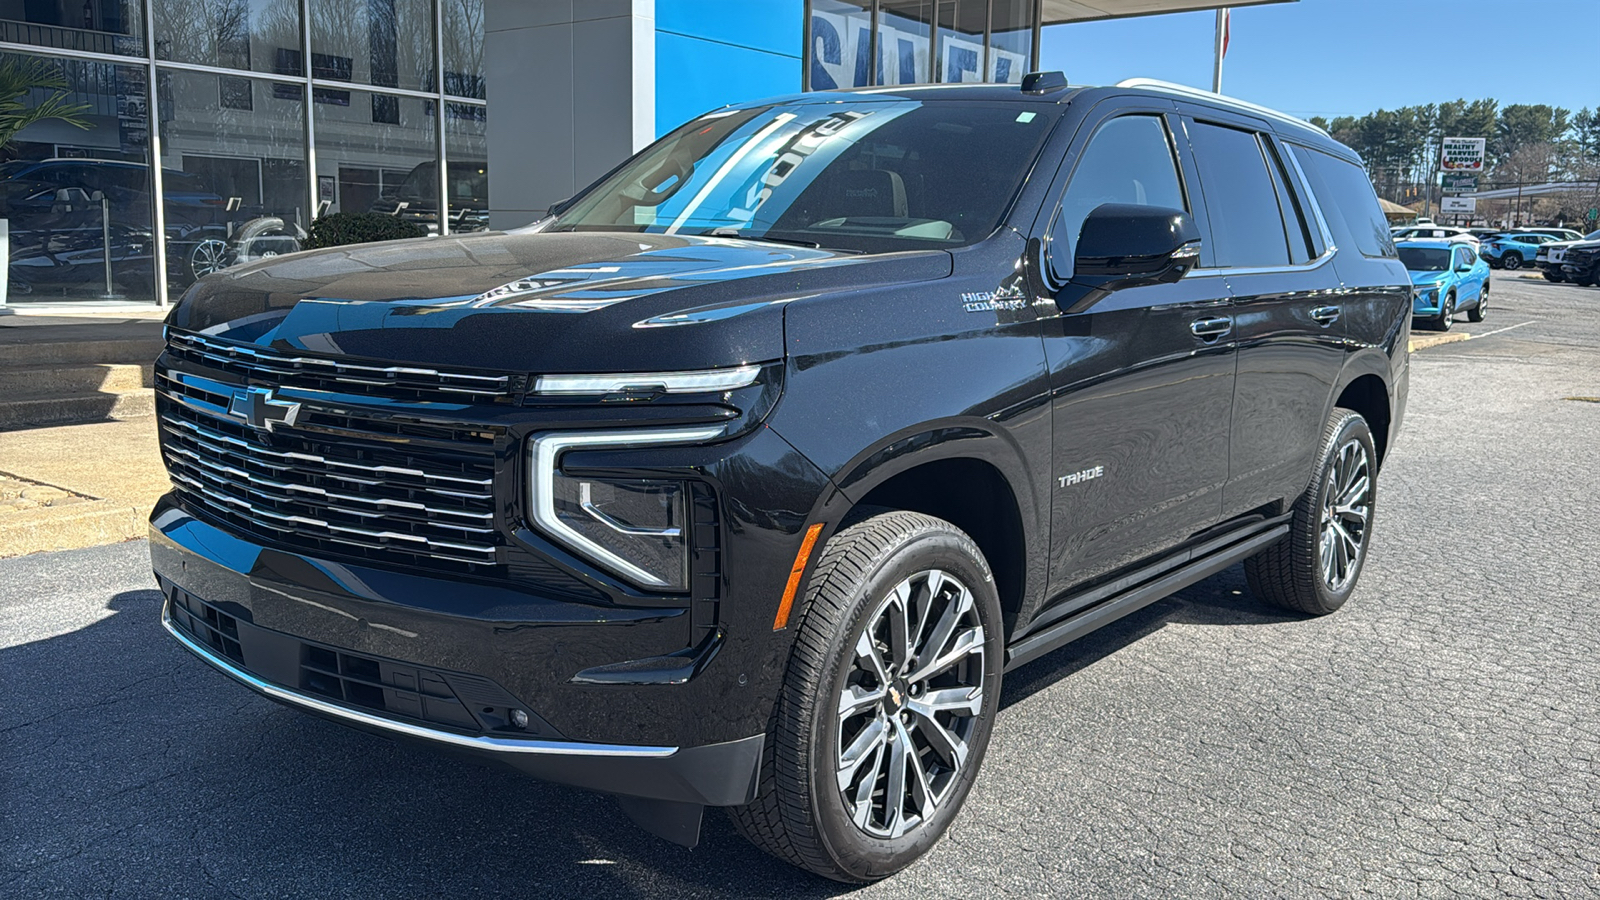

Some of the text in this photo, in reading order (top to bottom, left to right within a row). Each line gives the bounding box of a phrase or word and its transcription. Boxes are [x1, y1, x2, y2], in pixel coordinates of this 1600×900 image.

[961, 291, 996, 303] HIGH
[963, 299, 1027, 313] COUNTRY
[1058, 465, 1104, 488] TAHOE
